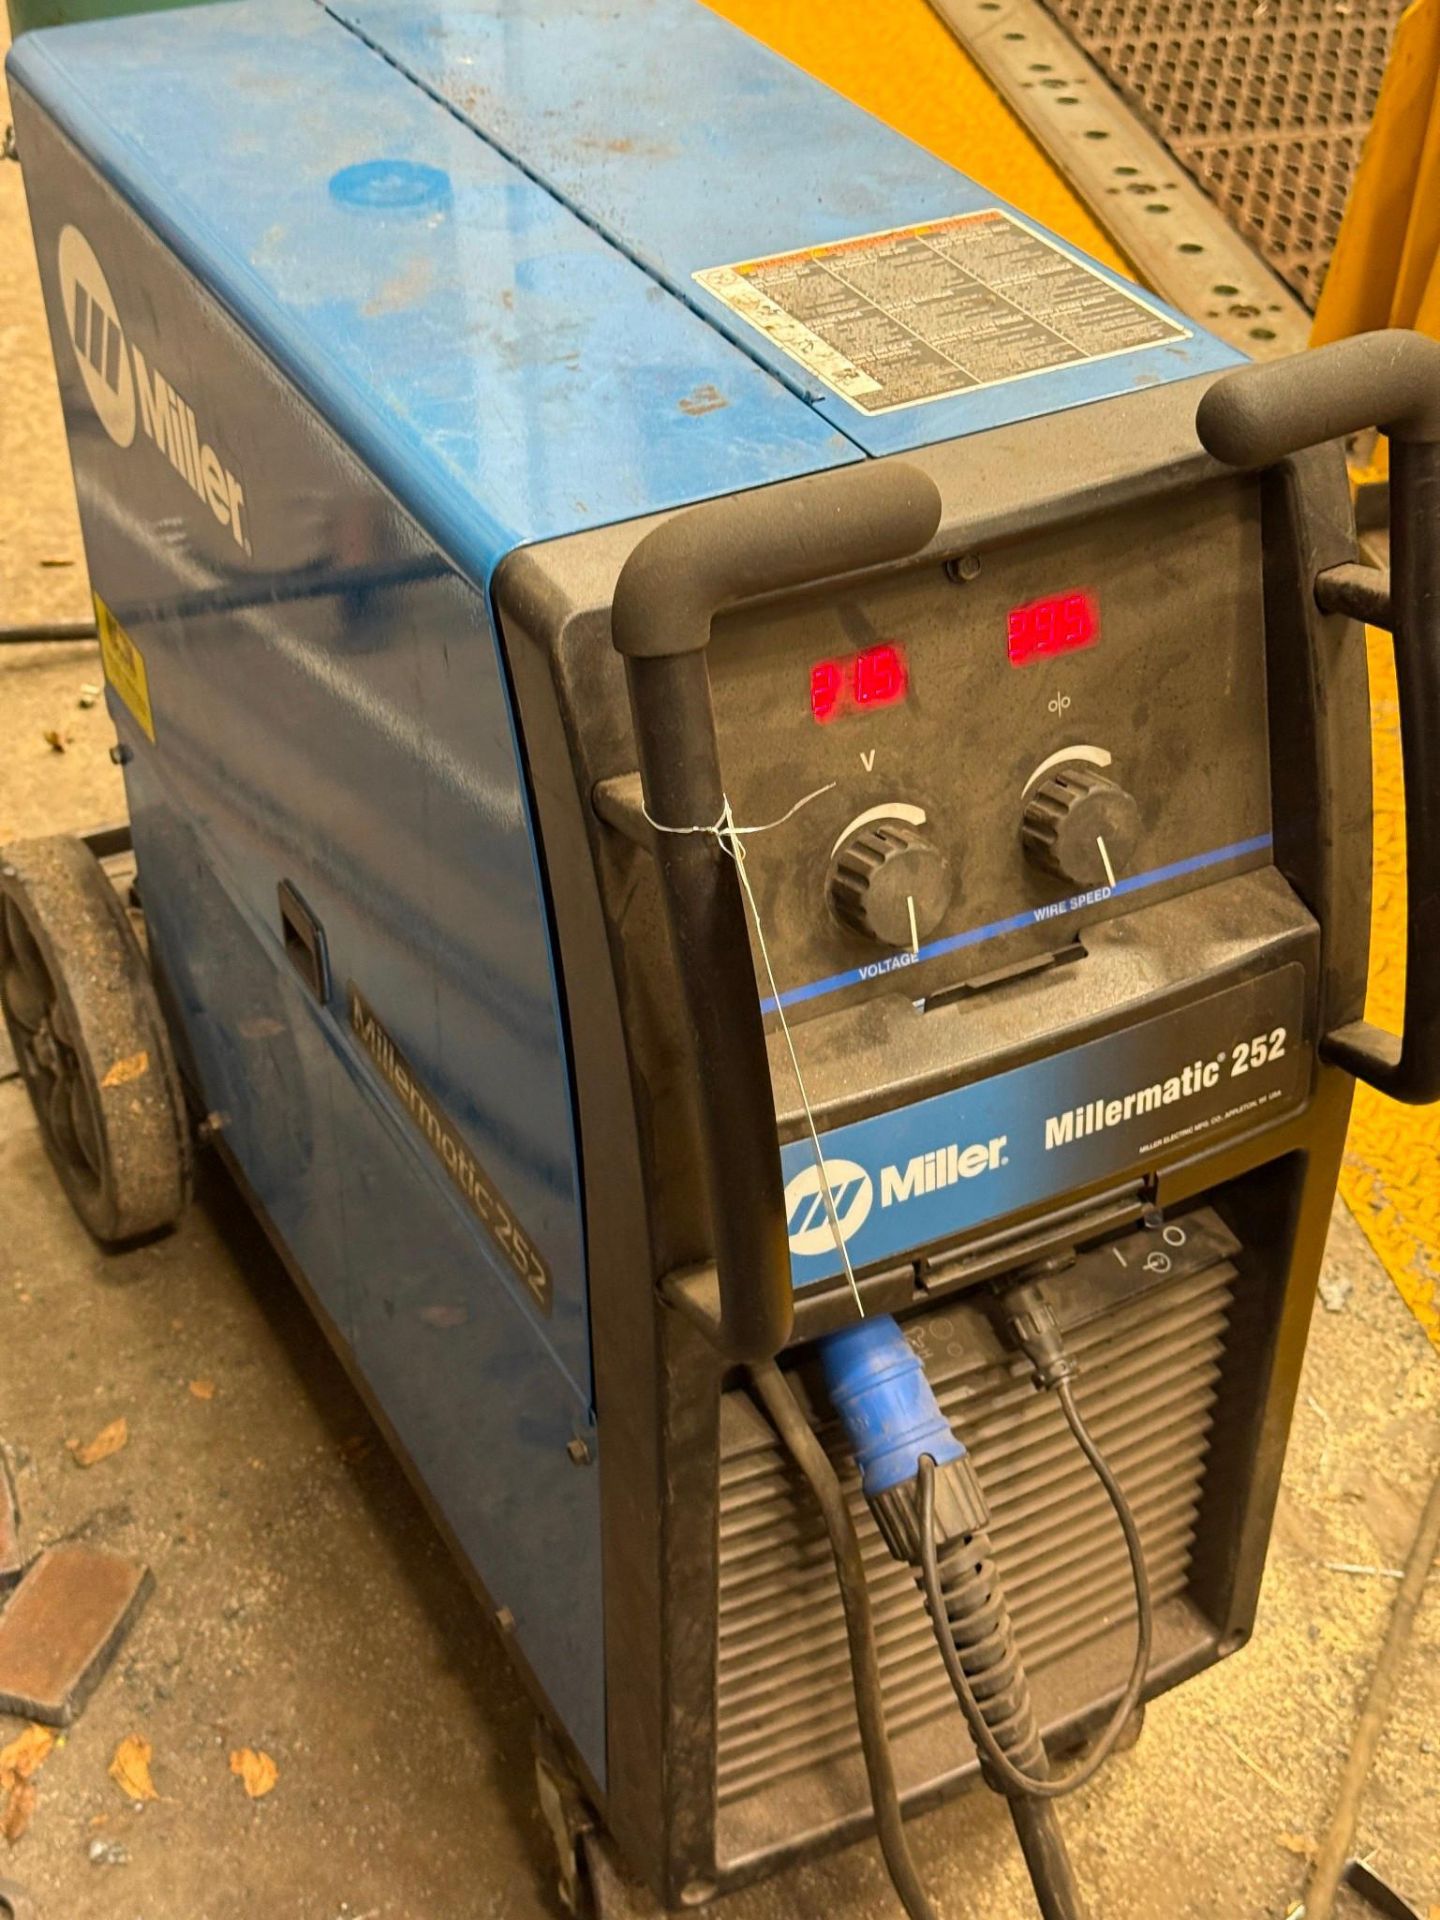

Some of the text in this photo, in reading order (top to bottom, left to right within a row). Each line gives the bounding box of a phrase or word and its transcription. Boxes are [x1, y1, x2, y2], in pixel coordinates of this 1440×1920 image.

[132, 343, 246, 550] Miller
[860, 749, 876, 772] V
[1034, 886, 1112, 922] WIRE SPEED
[858, 951, 919, 980] VOLTAGE
[1231, 1027, 1287, 1077] 252
[353, 994, 547, 1302] Millermatic 252
[1139, 1138, 1163, 1153] MILLER
[1163, 1126, 1193, 1144] ELECTRIC
[881, 1135, 1007, 1209] Miller
